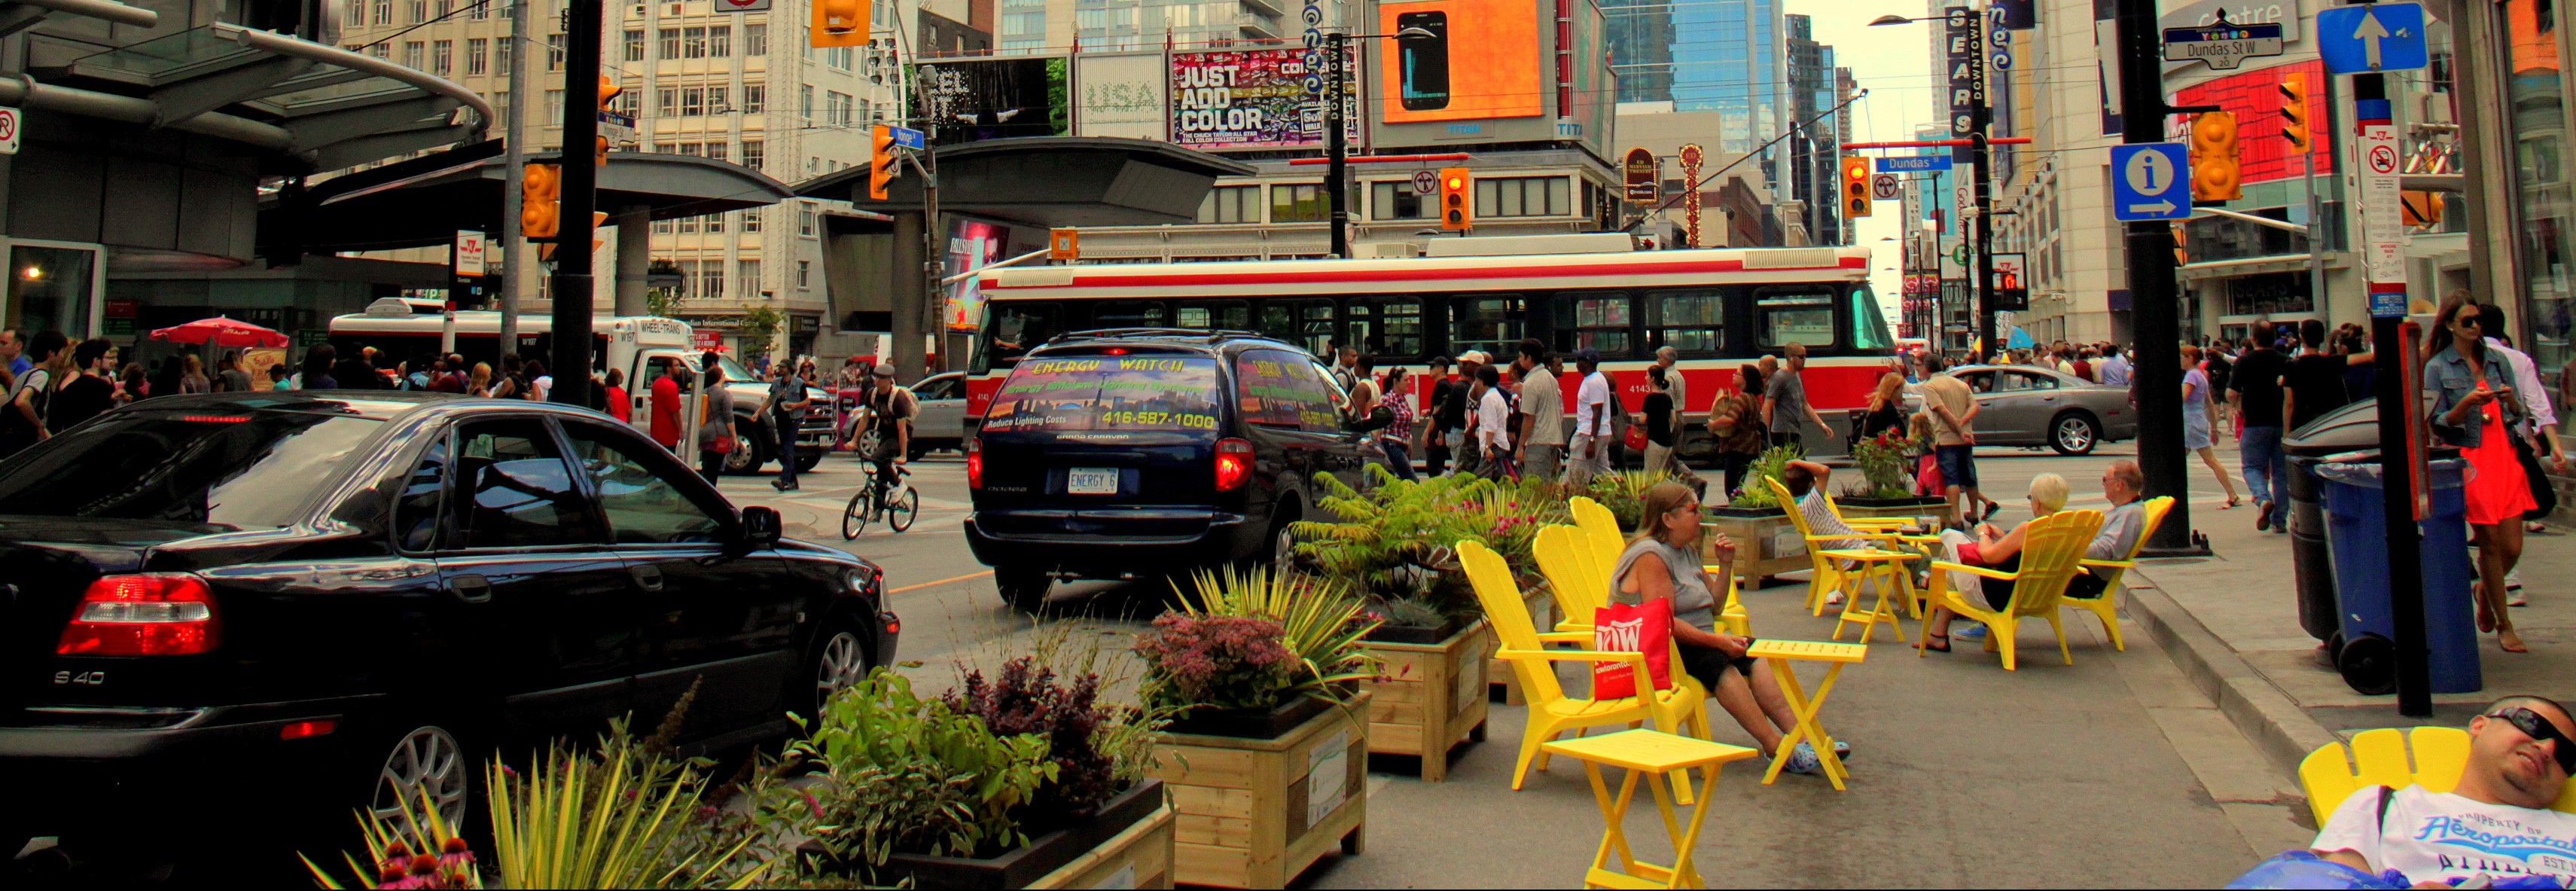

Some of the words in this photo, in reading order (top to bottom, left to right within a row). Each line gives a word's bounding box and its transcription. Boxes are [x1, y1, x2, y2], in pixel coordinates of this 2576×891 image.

[2187, 43, 2229, 56] Dundas
[2233, 42, 2242, 55] St
[2245, 41, 2255, 53] W
[1970, 18, 1983, 100] DOWNTOWN
[1181, 65, 1239, 88] JUST
[1950, 10, 1971, 133] SEARS
[1331, 41, 1339, 120] DOWNTOWN
[1085, 81, 1160, 114] USA
[1181, 87, 1231, 110] ADD
[1181, 108, 1263, 132] COLOR
[898, 128, 913, 143] Yonge
[1446, 124, 1482, 134] TITAN
[1889, 157, 1930, 169] Dundas
[641, 322, 681, 334] WHEEL-TRANS
[621, 332, 636, 343] W197
[1032, 360, 1102, 374] ENERGY
[1119, 359, 1184, 373] WATCH
[988, 420, 1013, 428] Reduce
[1015, 417, 1044, 427] Lighting
[1046, 416, 1066, 424] Costs
[1102, 411, 1215, 429] 416-587-1000
[1071, 474, 1105, 487] ENERGY
[1109, 474, 1116, 487] 6
[2458, 812, 2520, 830] PROPERTY
